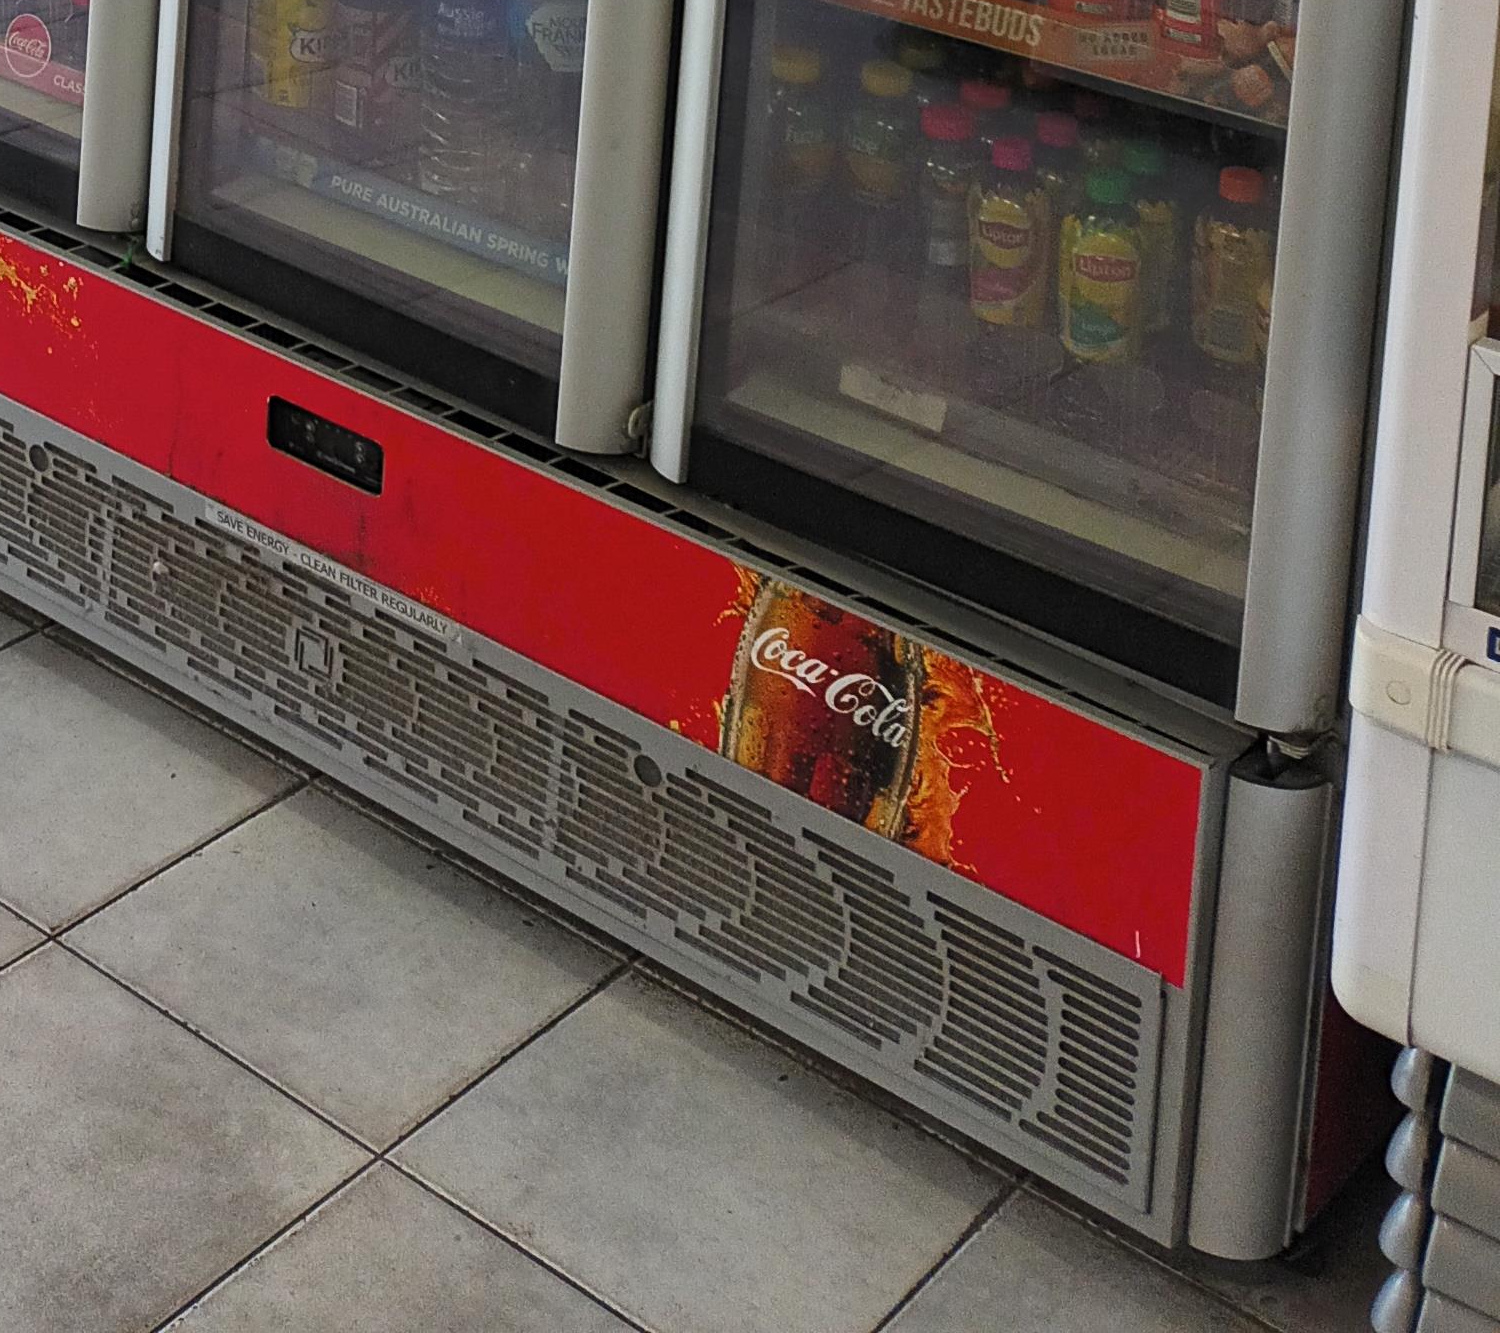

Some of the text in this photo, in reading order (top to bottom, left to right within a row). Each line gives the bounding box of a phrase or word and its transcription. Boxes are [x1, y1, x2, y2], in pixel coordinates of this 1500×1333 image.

[330, 174, 374, 204] PURE
[376, 192, 483, 244] AUSTRALIAN
[486, 233, 550, 269] SPRING
[1078, 259, 1132, 278] Lipton
[216, 510, 244, 533] SAVE
[245, 524, 291, 556] ENERGY
[300, 552, 337, 580] CLEAN
[339, 573, 379, 602] FILTER
[380, 592, 449, 634] REGULARLY
